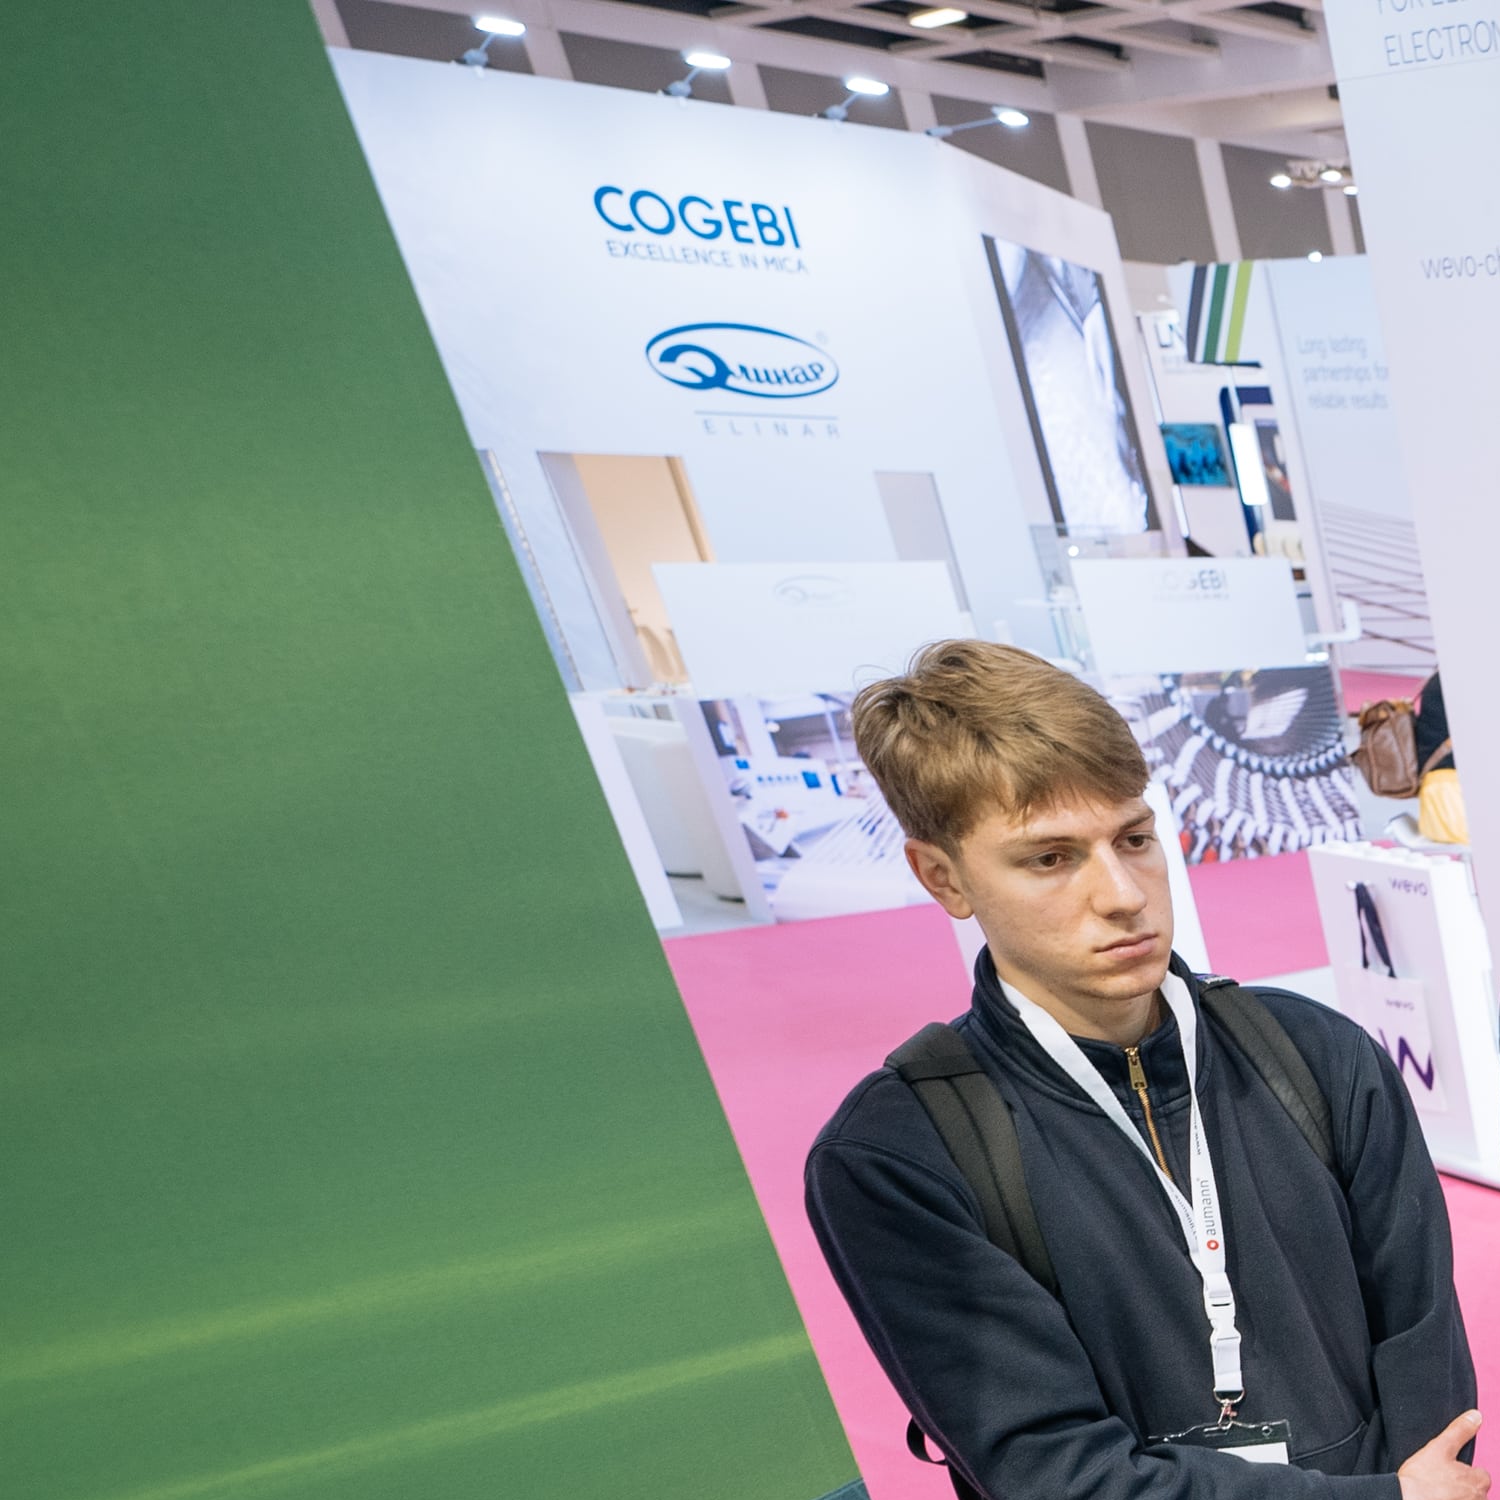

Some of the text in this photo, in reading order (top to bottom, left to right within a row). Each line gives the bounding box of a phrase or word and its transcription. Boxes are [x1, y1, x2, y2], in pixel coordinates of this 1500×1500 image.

[593, 185, 801, 249] COGEBI
[606, 240, 809, 275] EXCELLENCE IN MICA
[702, 418, 840, 438] ELINAR
[1200, 1179, 1217, 1236] aumann
